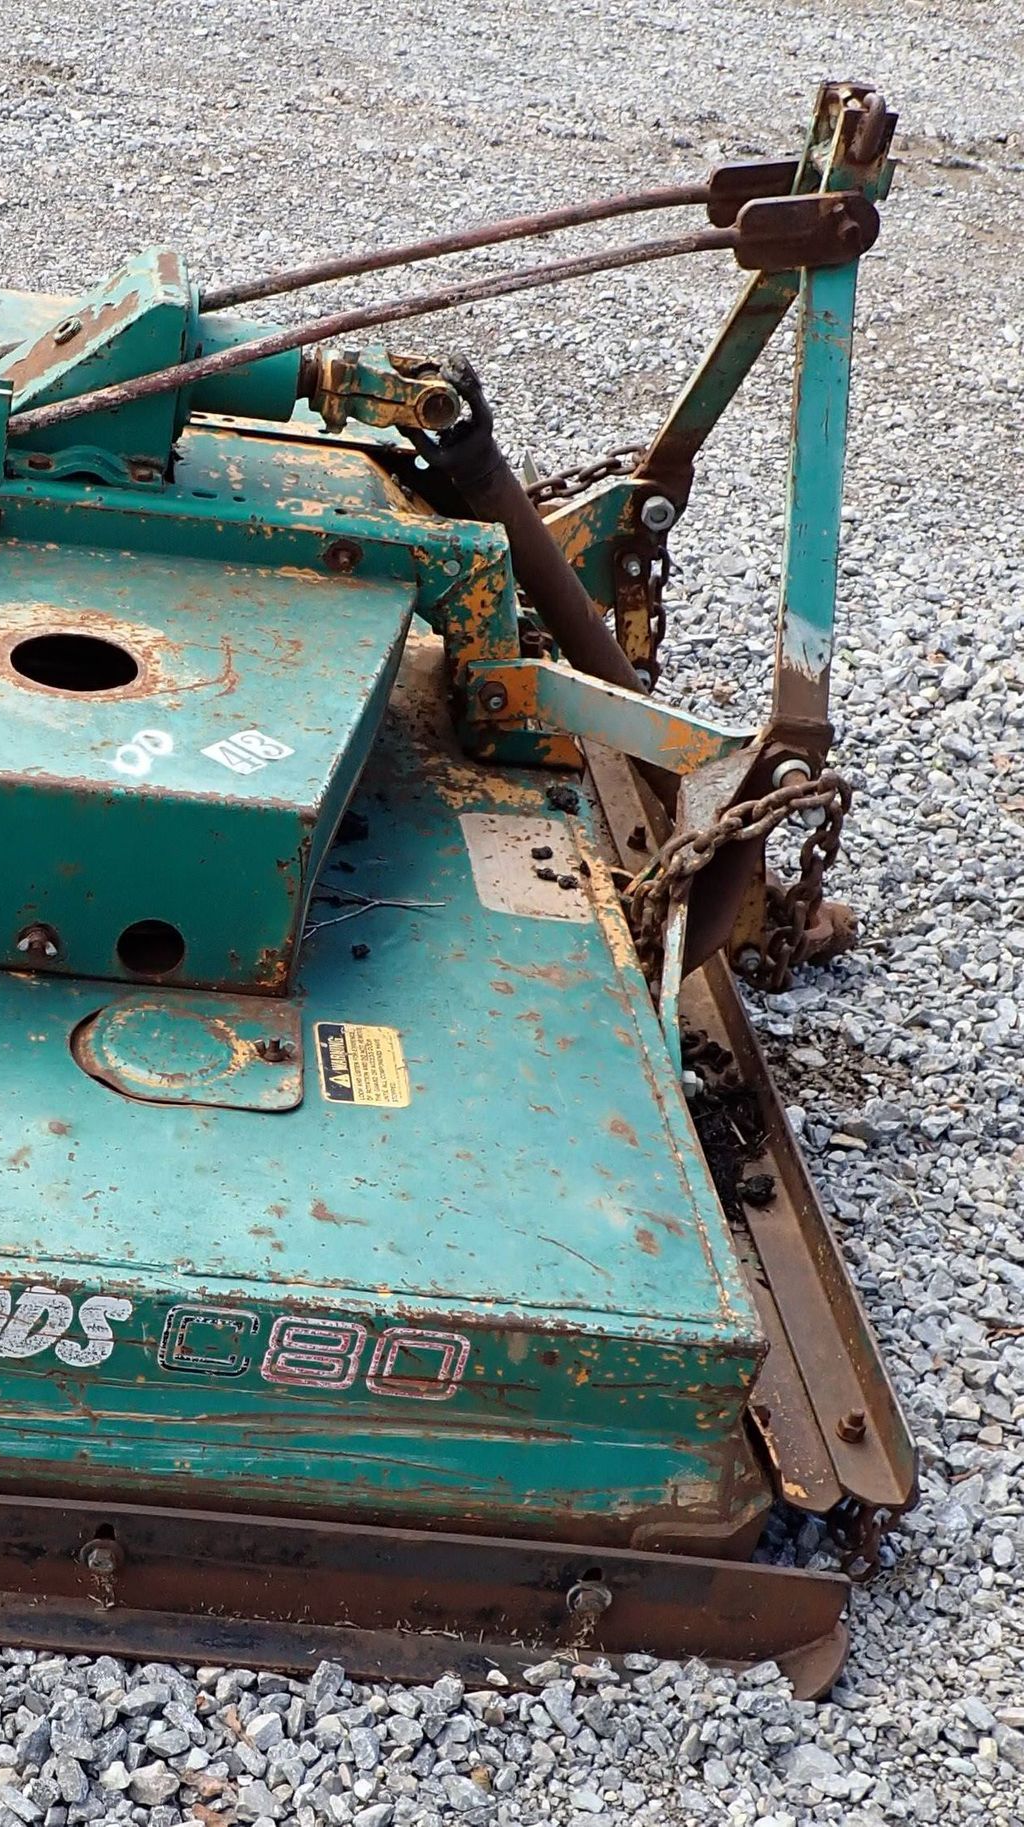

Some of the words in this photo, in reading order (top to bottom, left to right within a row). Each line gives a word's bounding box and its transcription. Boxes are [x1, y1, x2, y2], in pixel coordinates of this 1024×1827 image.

[214, 732, 288, 771] 43
[328, 1035, 348, 1070] WARNING
[158, 1305, 470, 1400] C80
